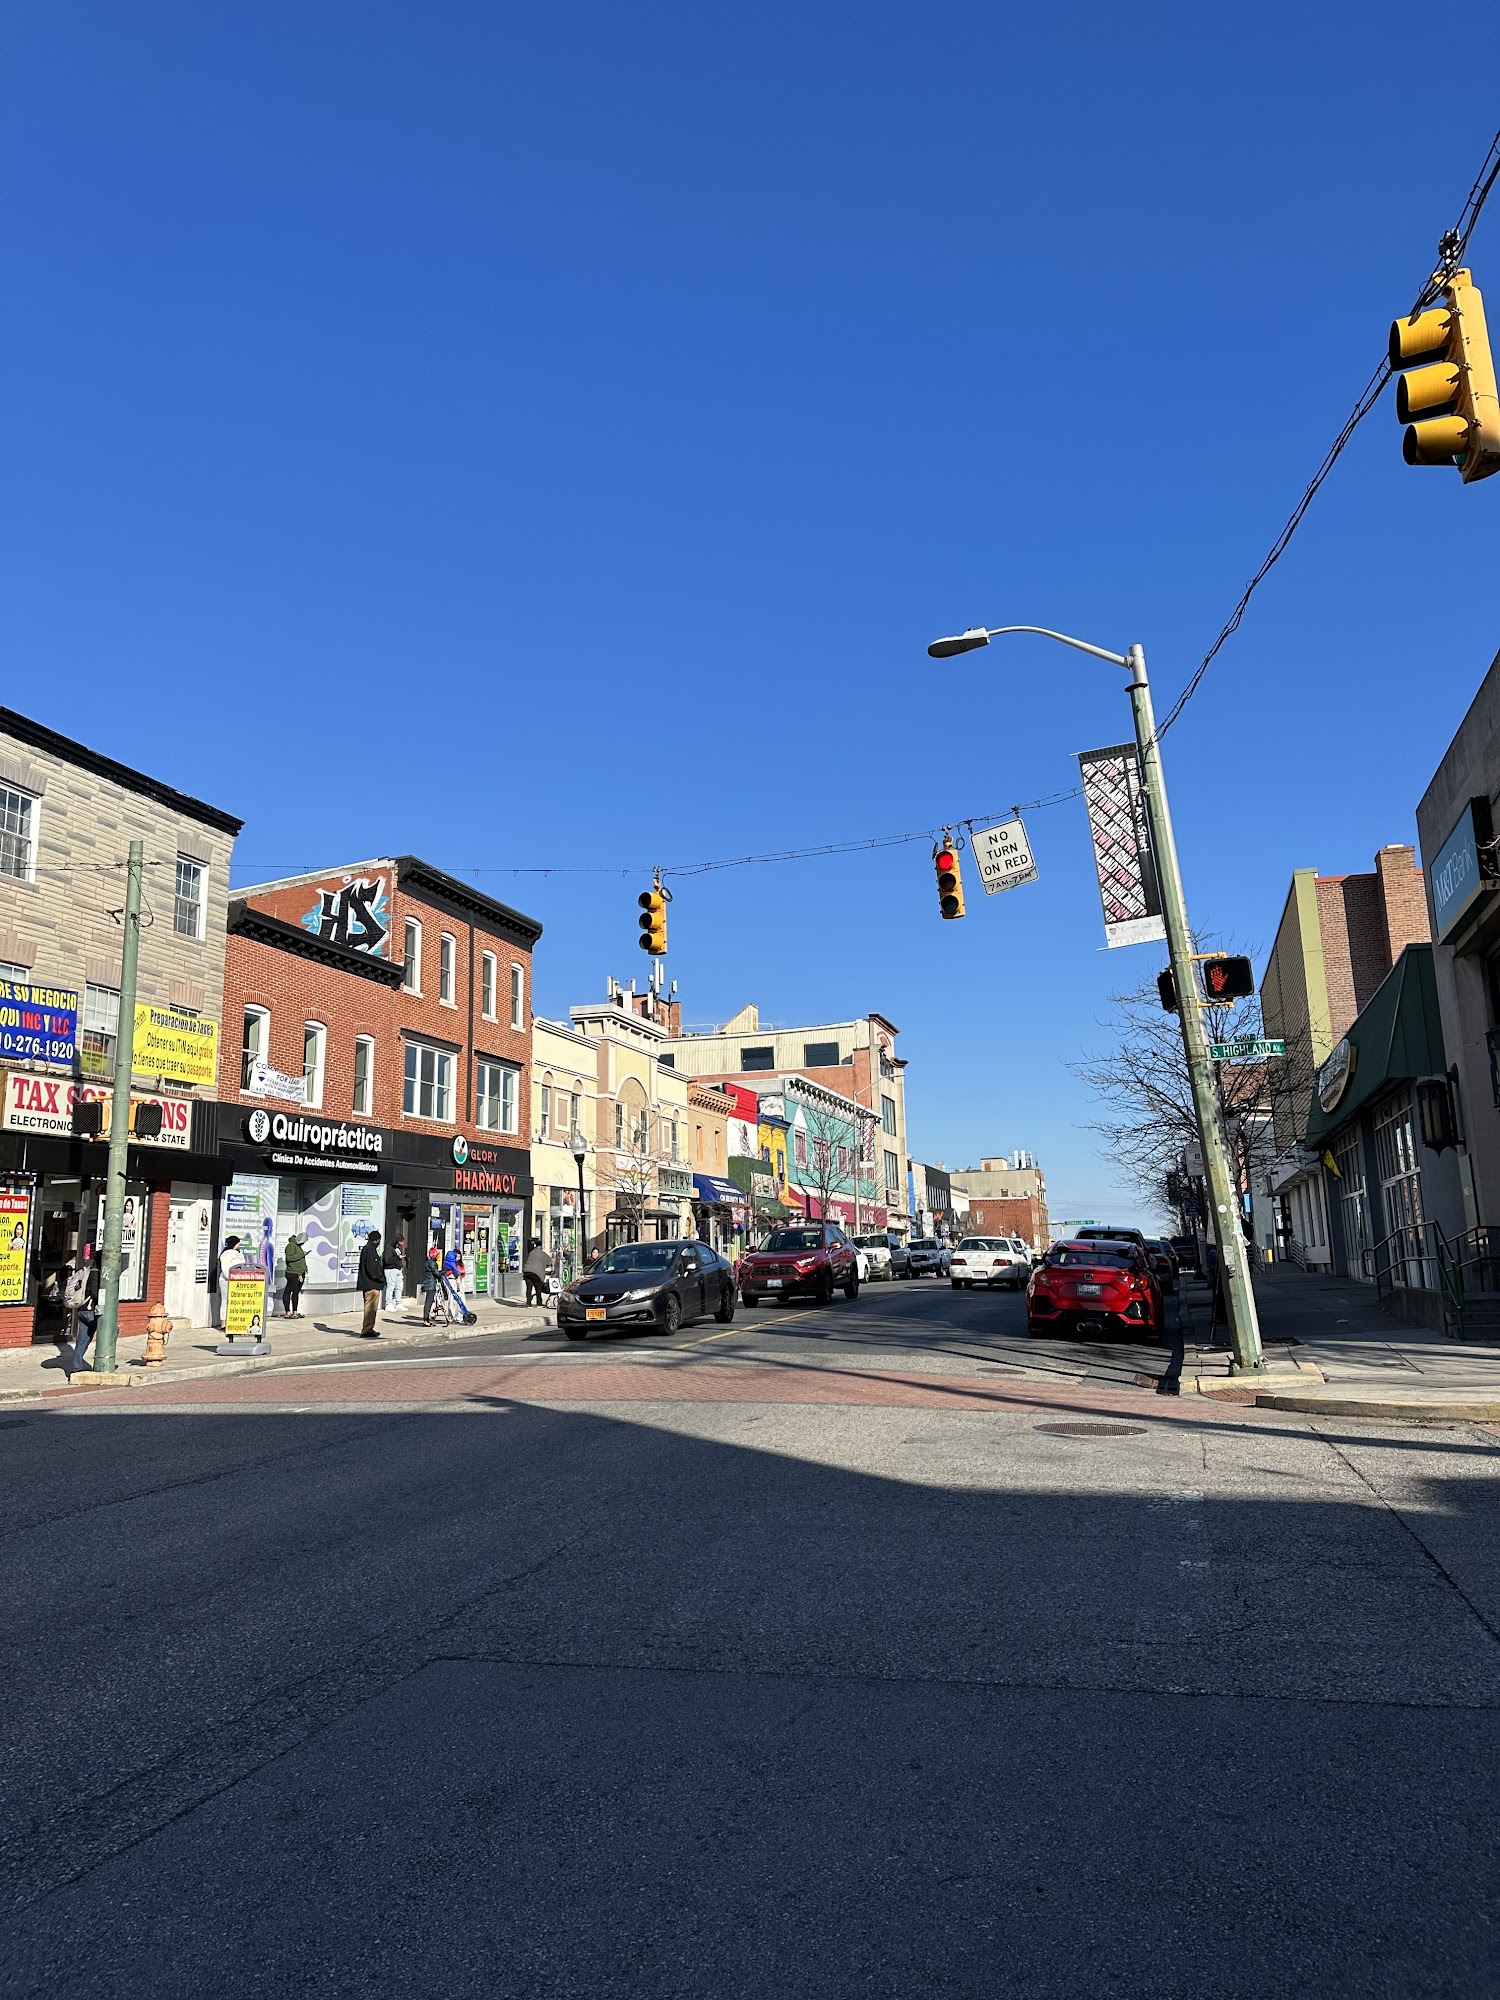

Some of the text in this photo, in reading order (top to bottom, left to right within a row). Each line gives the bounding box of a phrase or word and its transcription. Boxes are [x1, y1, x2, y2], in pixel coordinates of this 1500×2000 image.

[988, 830, 1008, 845] NO
[1137, 826, 1150, 854] Street
[986, 842, 1018, 860] TURN
[984, 854, 1028, 876] ON RED
[13, 985, 29, 1002] SU
[31, 986, 77, 1012] NEGOCIO
[22, 1011, 42, 1031] INC
[43, 1014, 51, 1032] Y
[52, 1016, 70, 1036] LLC
[147, 1032, 168, 1051] Obtener
[168, 1040, 175, 1052] su
[175, 1039, 187, 1054] ITIN
[199, 1045, 213, 1061] gratis
[1212, 1046, 1221, 1058] S.
[1222, 1042, 1271, 1057] HIGHLAND
[137, 1051, 155, 1068] tienes
[156, 1058, 166, 1072] que
[166, 1058, 180, 1072] traer
[180, 1062, 186, 1074] su
[13, 1077, 60, 1114] TAX
[161, 1133, 186, 1145] STATE
[272, 1113, 383, 1152] Quiropráctica
[272, 1153, 294, 1164] Clínica
[295, 1156, 303, 1164] De
[304, 1157, 335, 1168] Accidentes
[470, 1148, 498, 1163] GLORY
[455, 1169, 516, 1194] PHARMACY
[0, 1278, 22, 1286] ABLA
